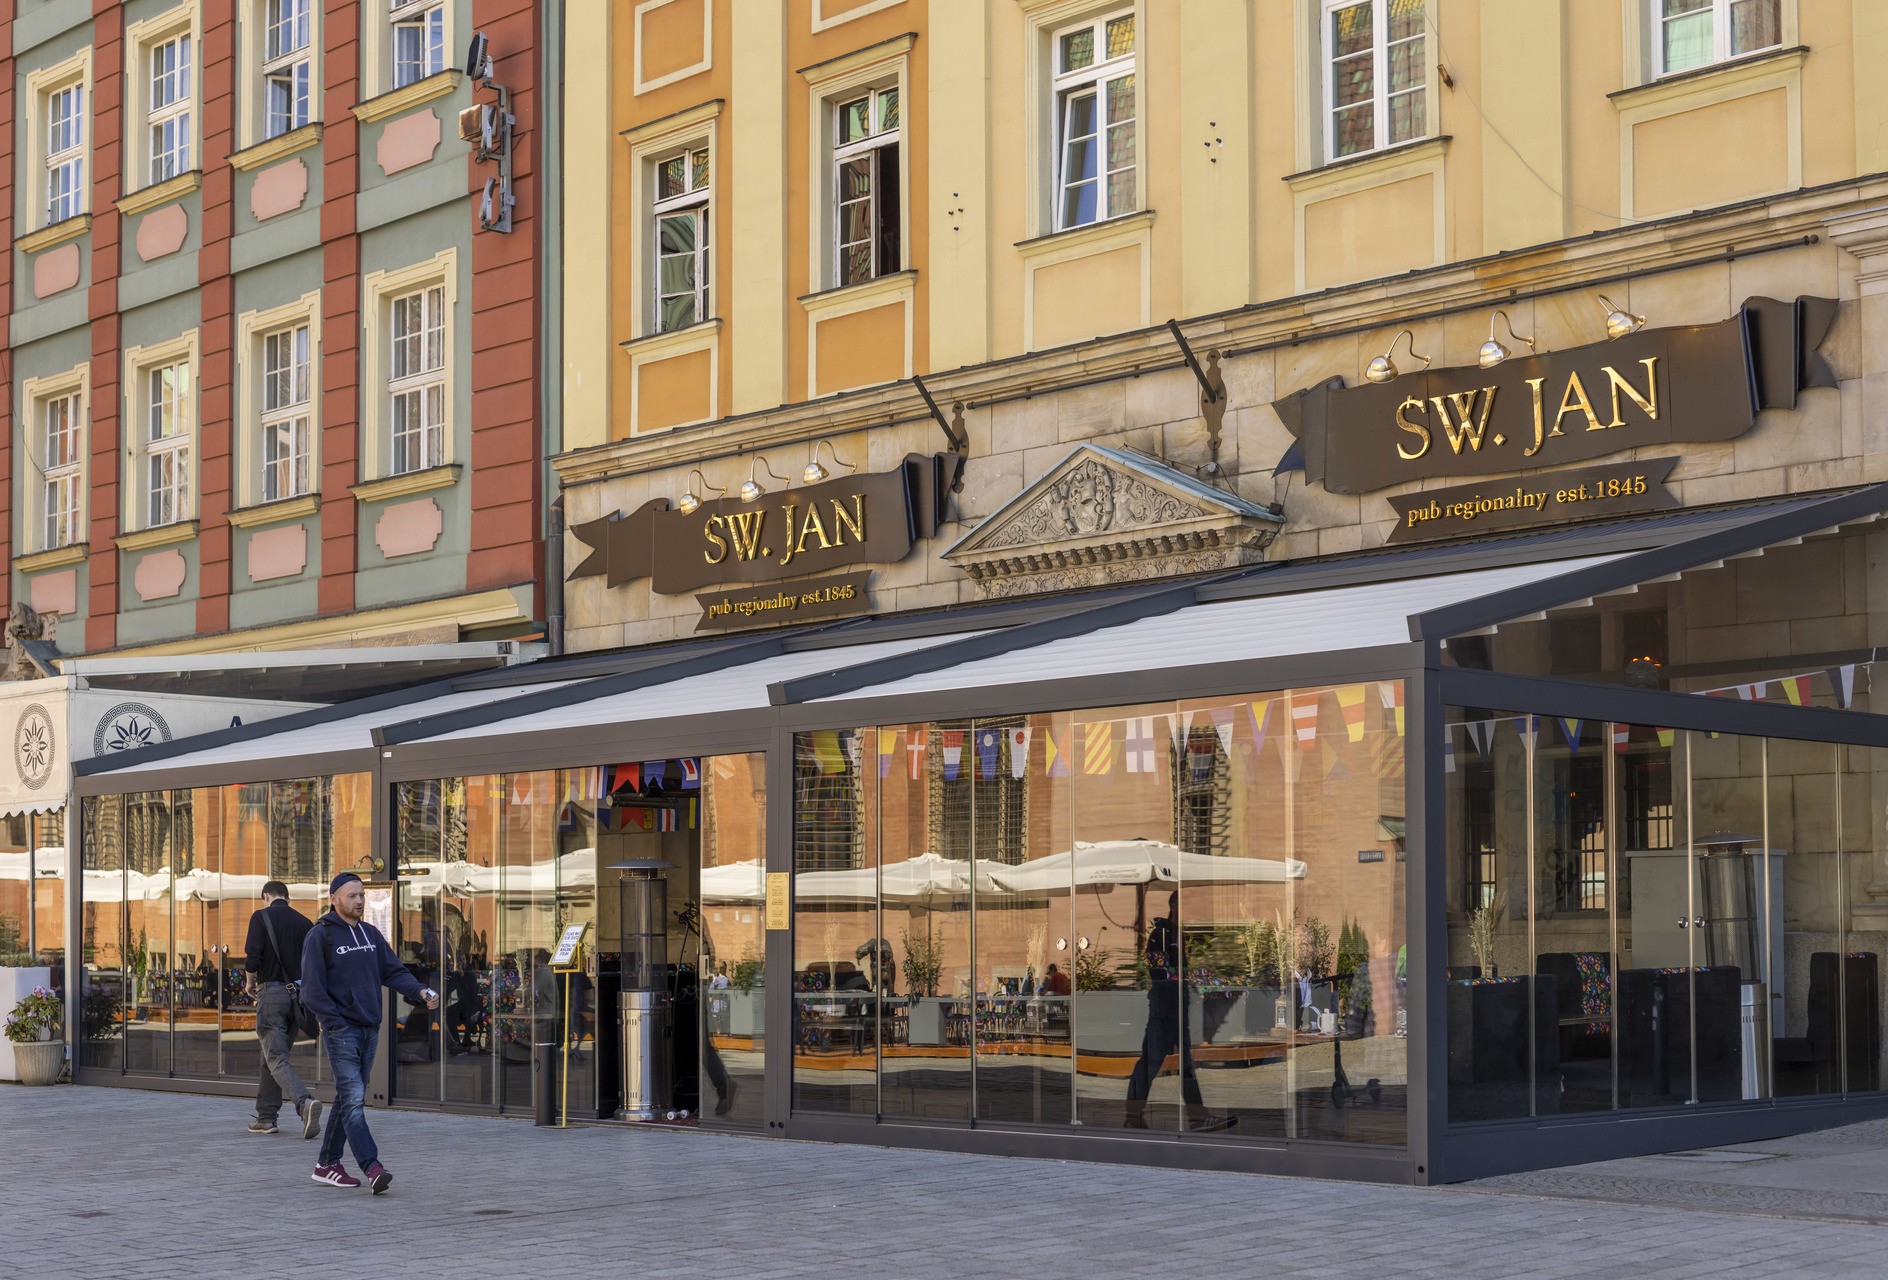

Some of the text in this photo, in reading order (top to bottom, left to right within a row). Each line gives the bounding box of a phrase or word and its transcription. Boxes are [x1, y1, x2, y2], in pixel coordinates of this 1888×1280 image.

[1523, 356, 1659, 458] JAN
[779, 493, 866, 566] JAN
[1407, 500, 1442, 528] pub
[1446, 487, 1548, 520] regionalny
[708, 598, 733, 619] pub
[734, 592, 798, 617] regionalny
